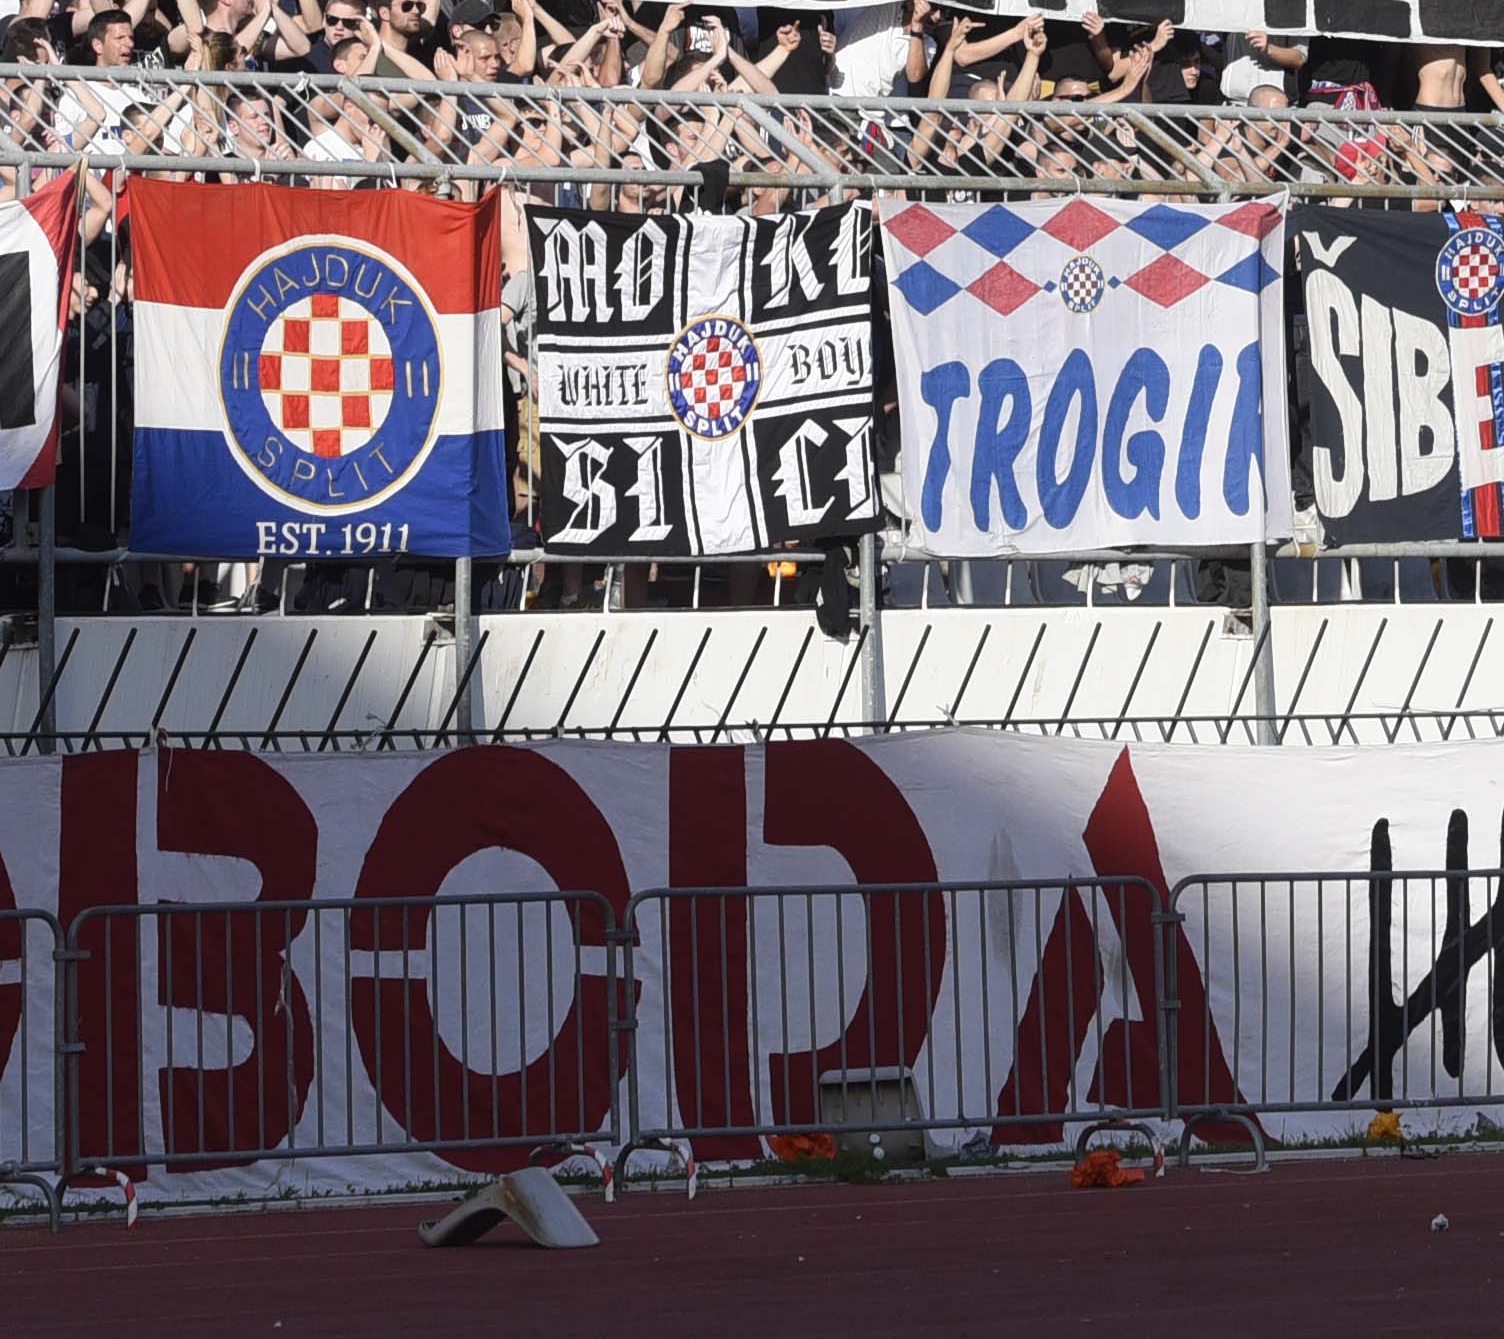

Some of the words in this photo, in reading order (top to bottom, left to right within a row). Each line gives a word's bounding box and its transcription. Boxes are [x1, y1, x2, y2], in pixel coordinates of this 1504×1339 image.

[1446, 234, 1504, 260] HAJDUK
[247, 251, 413, 325] HAJDUK
[673, 320, 752, 364] HAJDUK
[558, 363, 648, 406] WHITE
[684, 407, 744, 436] SPLIT
[256, 435, 394, 498] SPLIT
